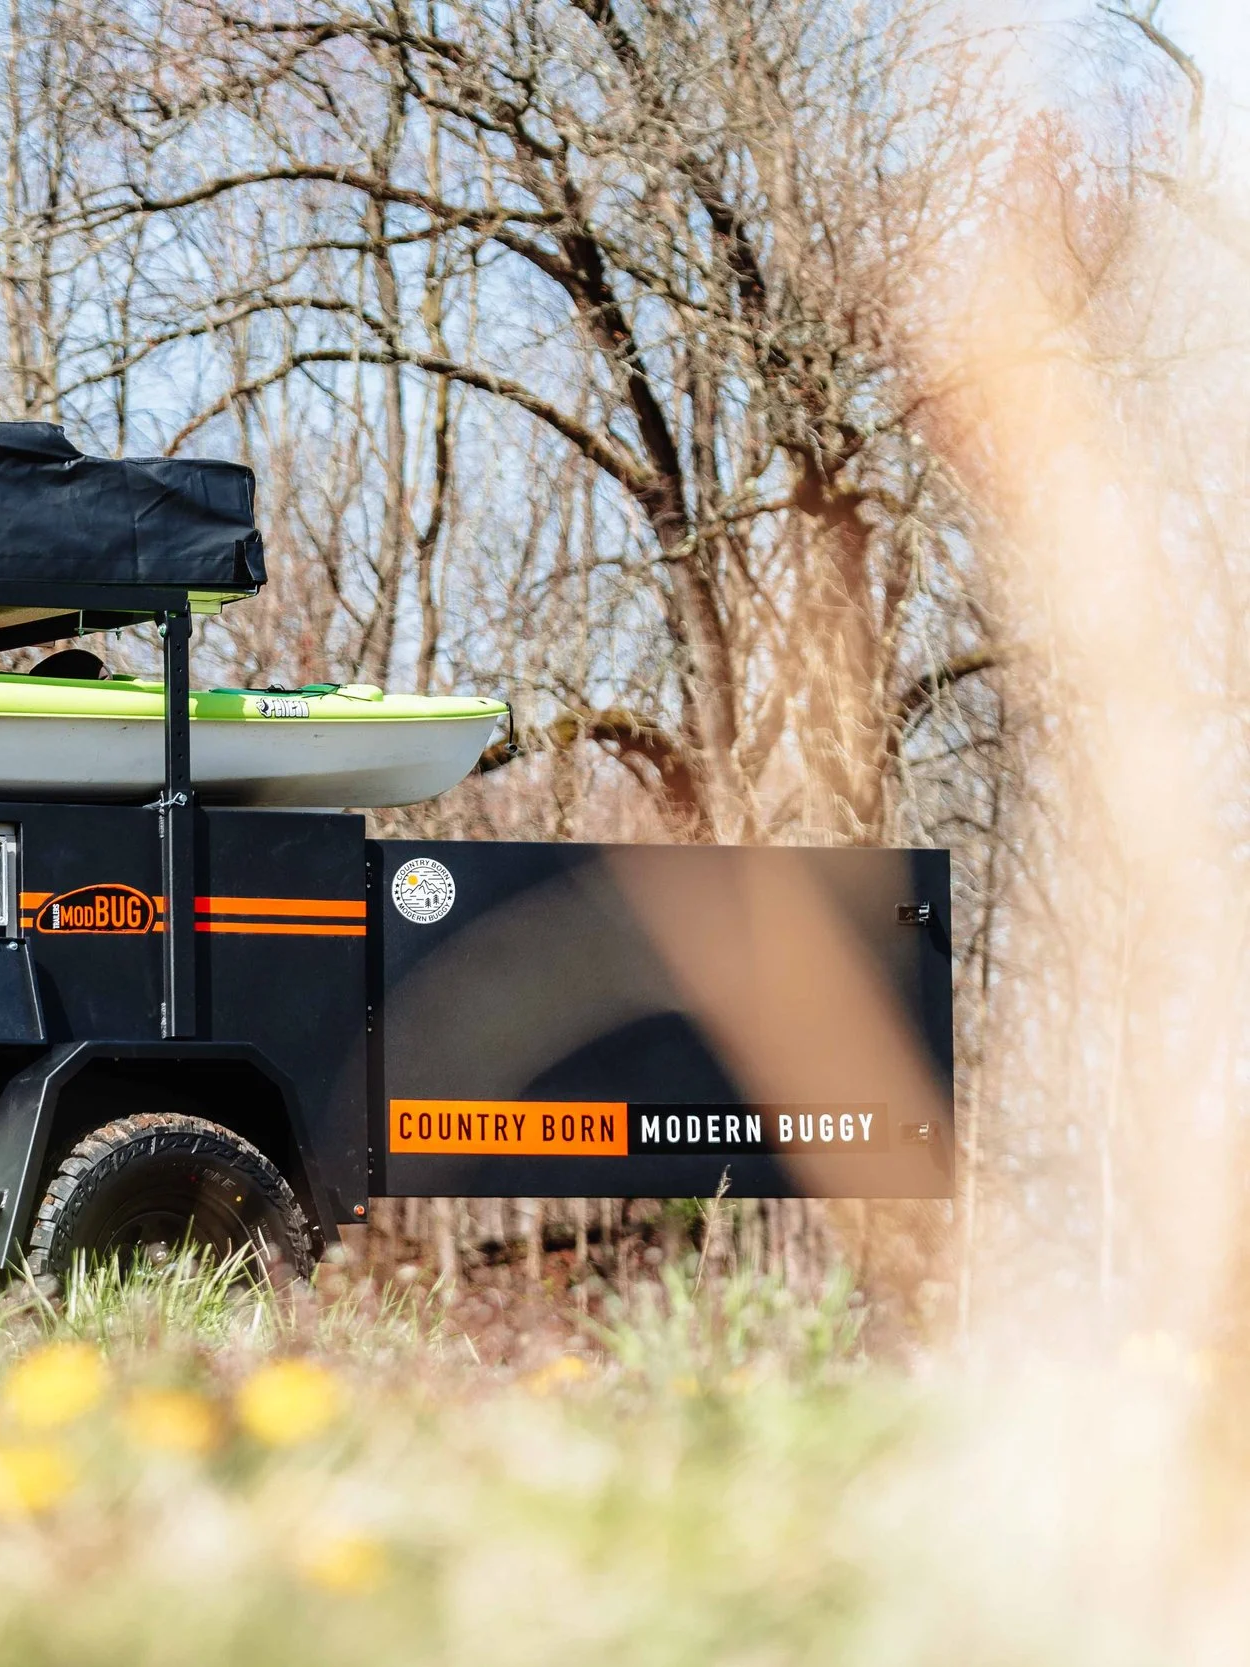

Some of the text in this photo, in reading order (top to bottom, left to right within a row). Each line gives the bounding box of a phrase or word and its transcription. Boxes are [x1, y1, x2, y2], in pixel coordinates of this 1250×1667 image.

[397, 859, 451, 881] COUNTRY BORN
[398, 902, 451, 922] MODERN BUGGY
[399, 1112, 874, 1144] COUNTRY BORN MODERN BUGGY
